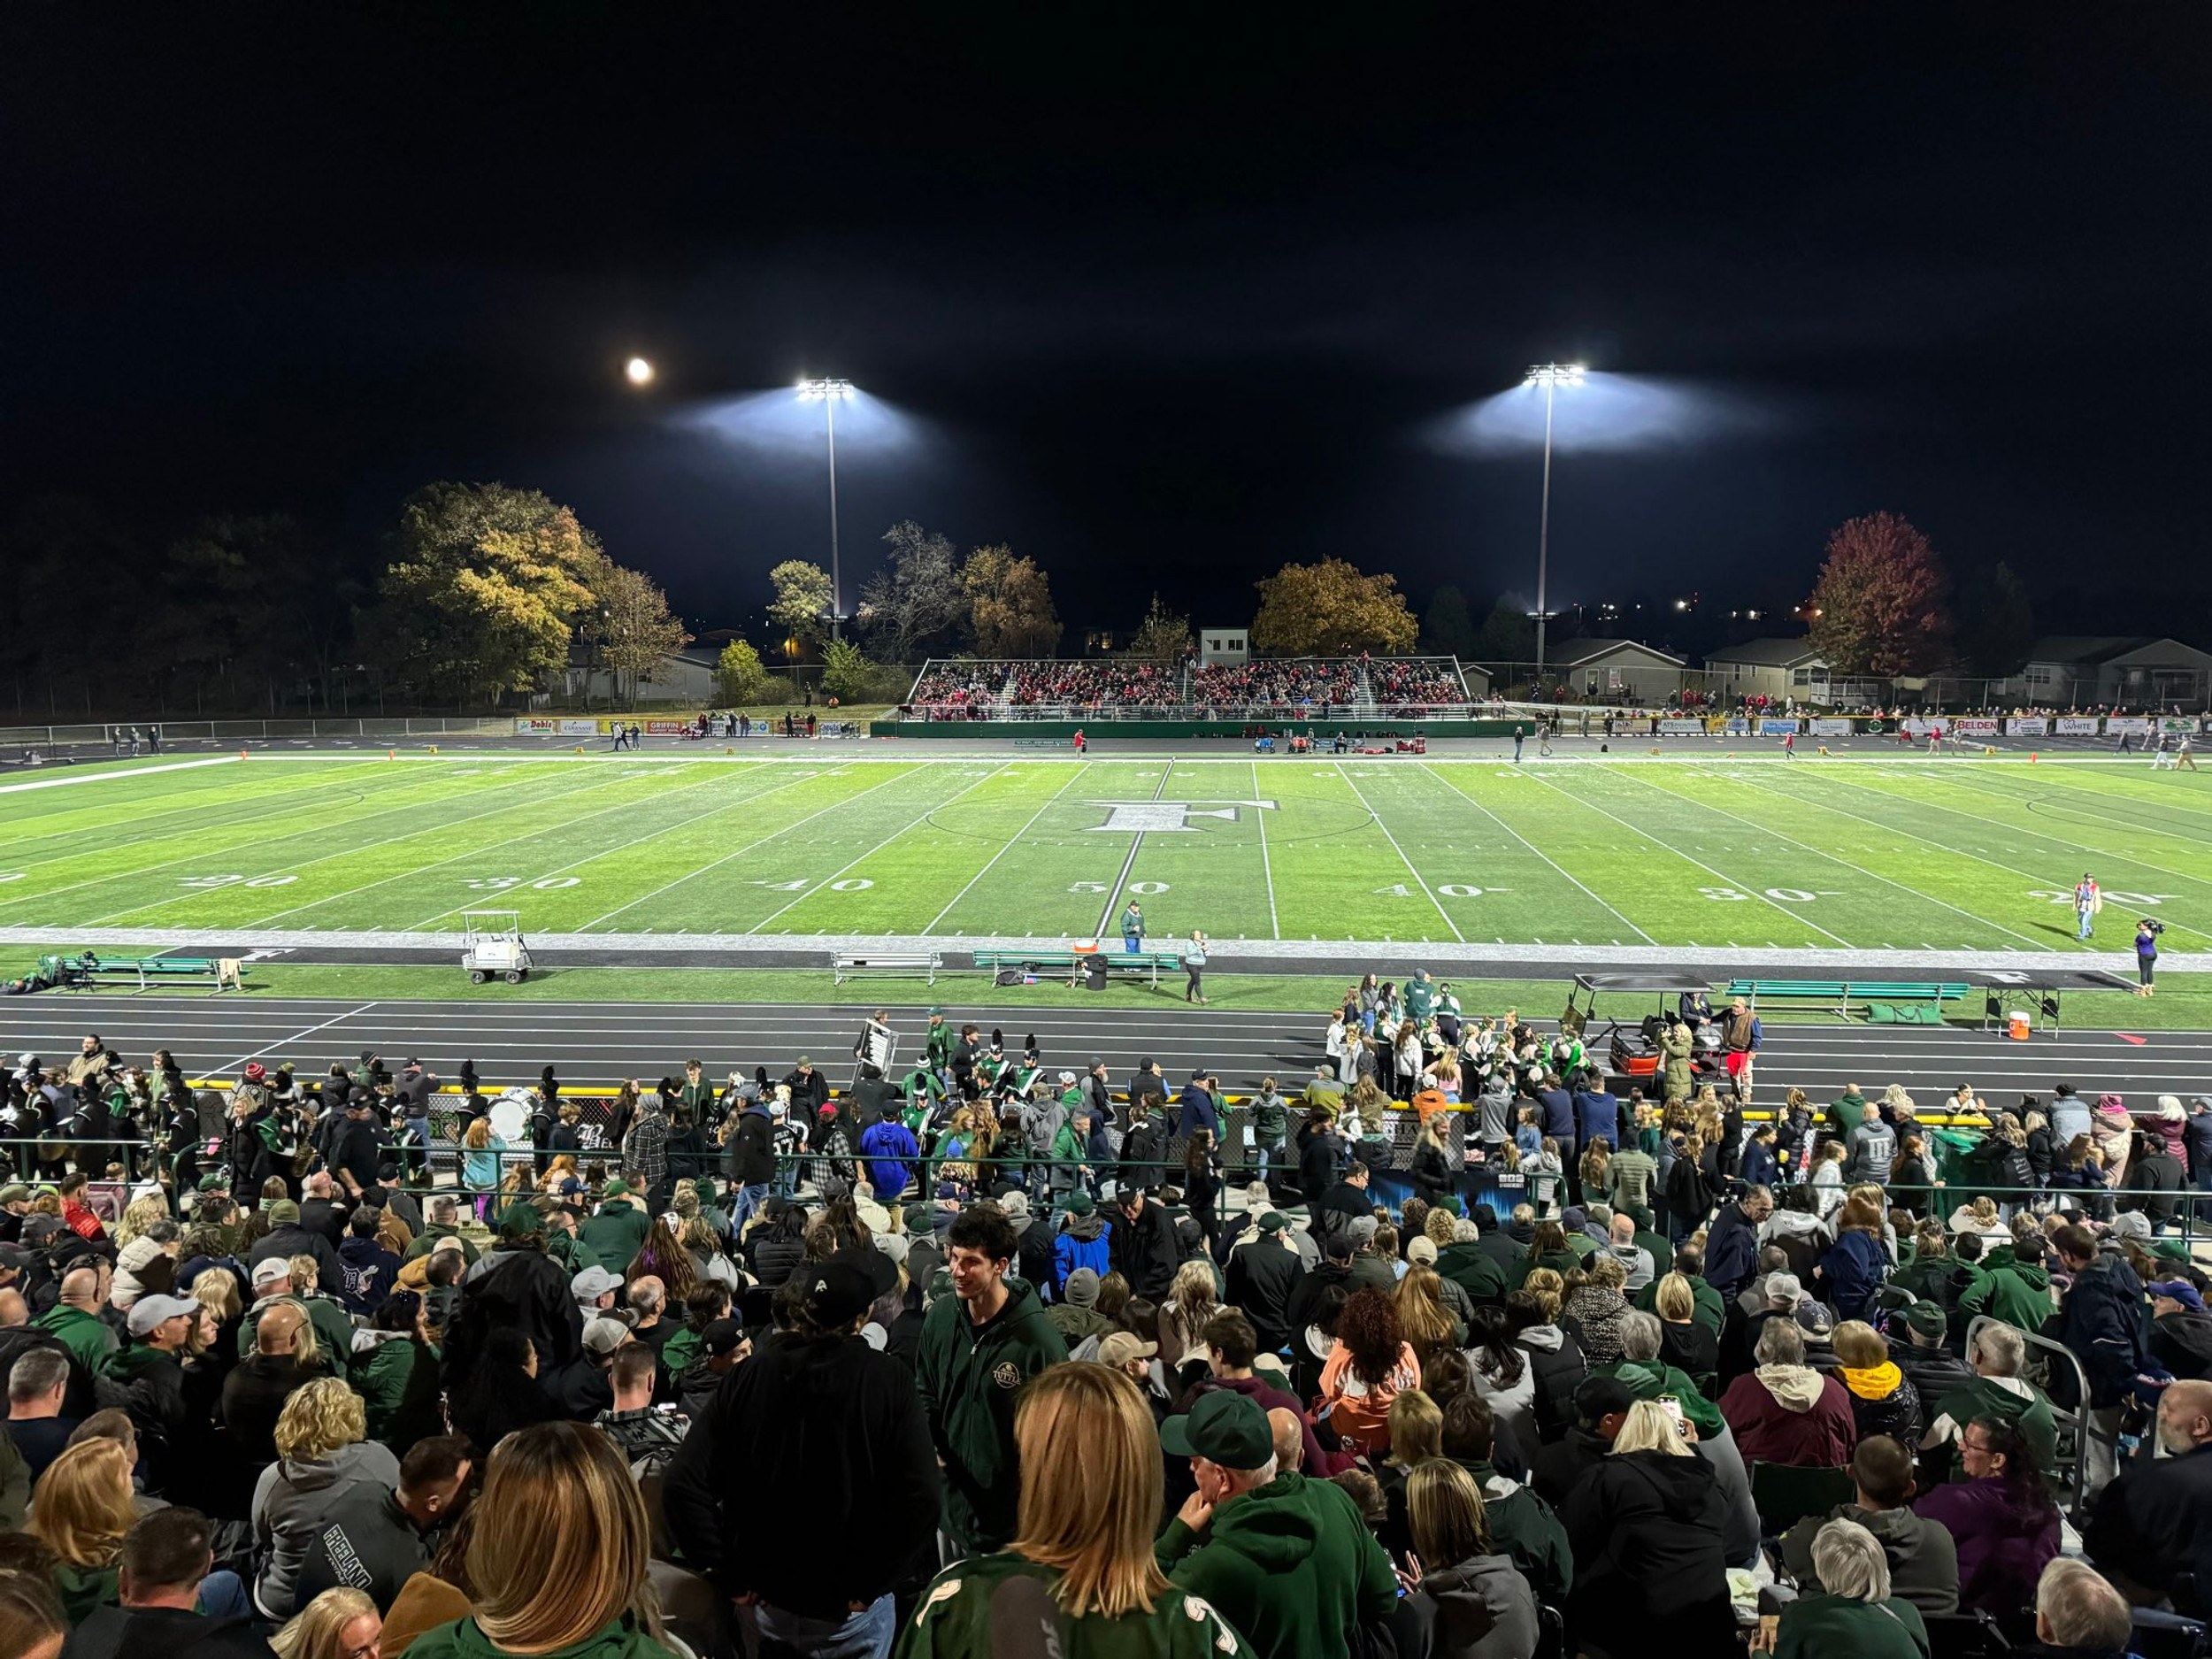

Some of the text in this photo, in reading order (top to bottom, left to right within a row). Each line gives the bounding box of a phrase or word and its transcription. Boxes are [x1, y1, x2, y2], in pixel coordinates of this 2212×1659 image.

[1958, 720, 1997, 730] BELDEN
[2063, 722, 2092, 731] WHITE
[468, 877, 581, 889] 30
[764, 879, 874, 891] 40
[1067, 881, 1171, 895] 50
[1372, 884, 1483, 897] 40
[1696, 887, 1816, 902] 30
[322, 1524, 373, 1590] FREELAND
